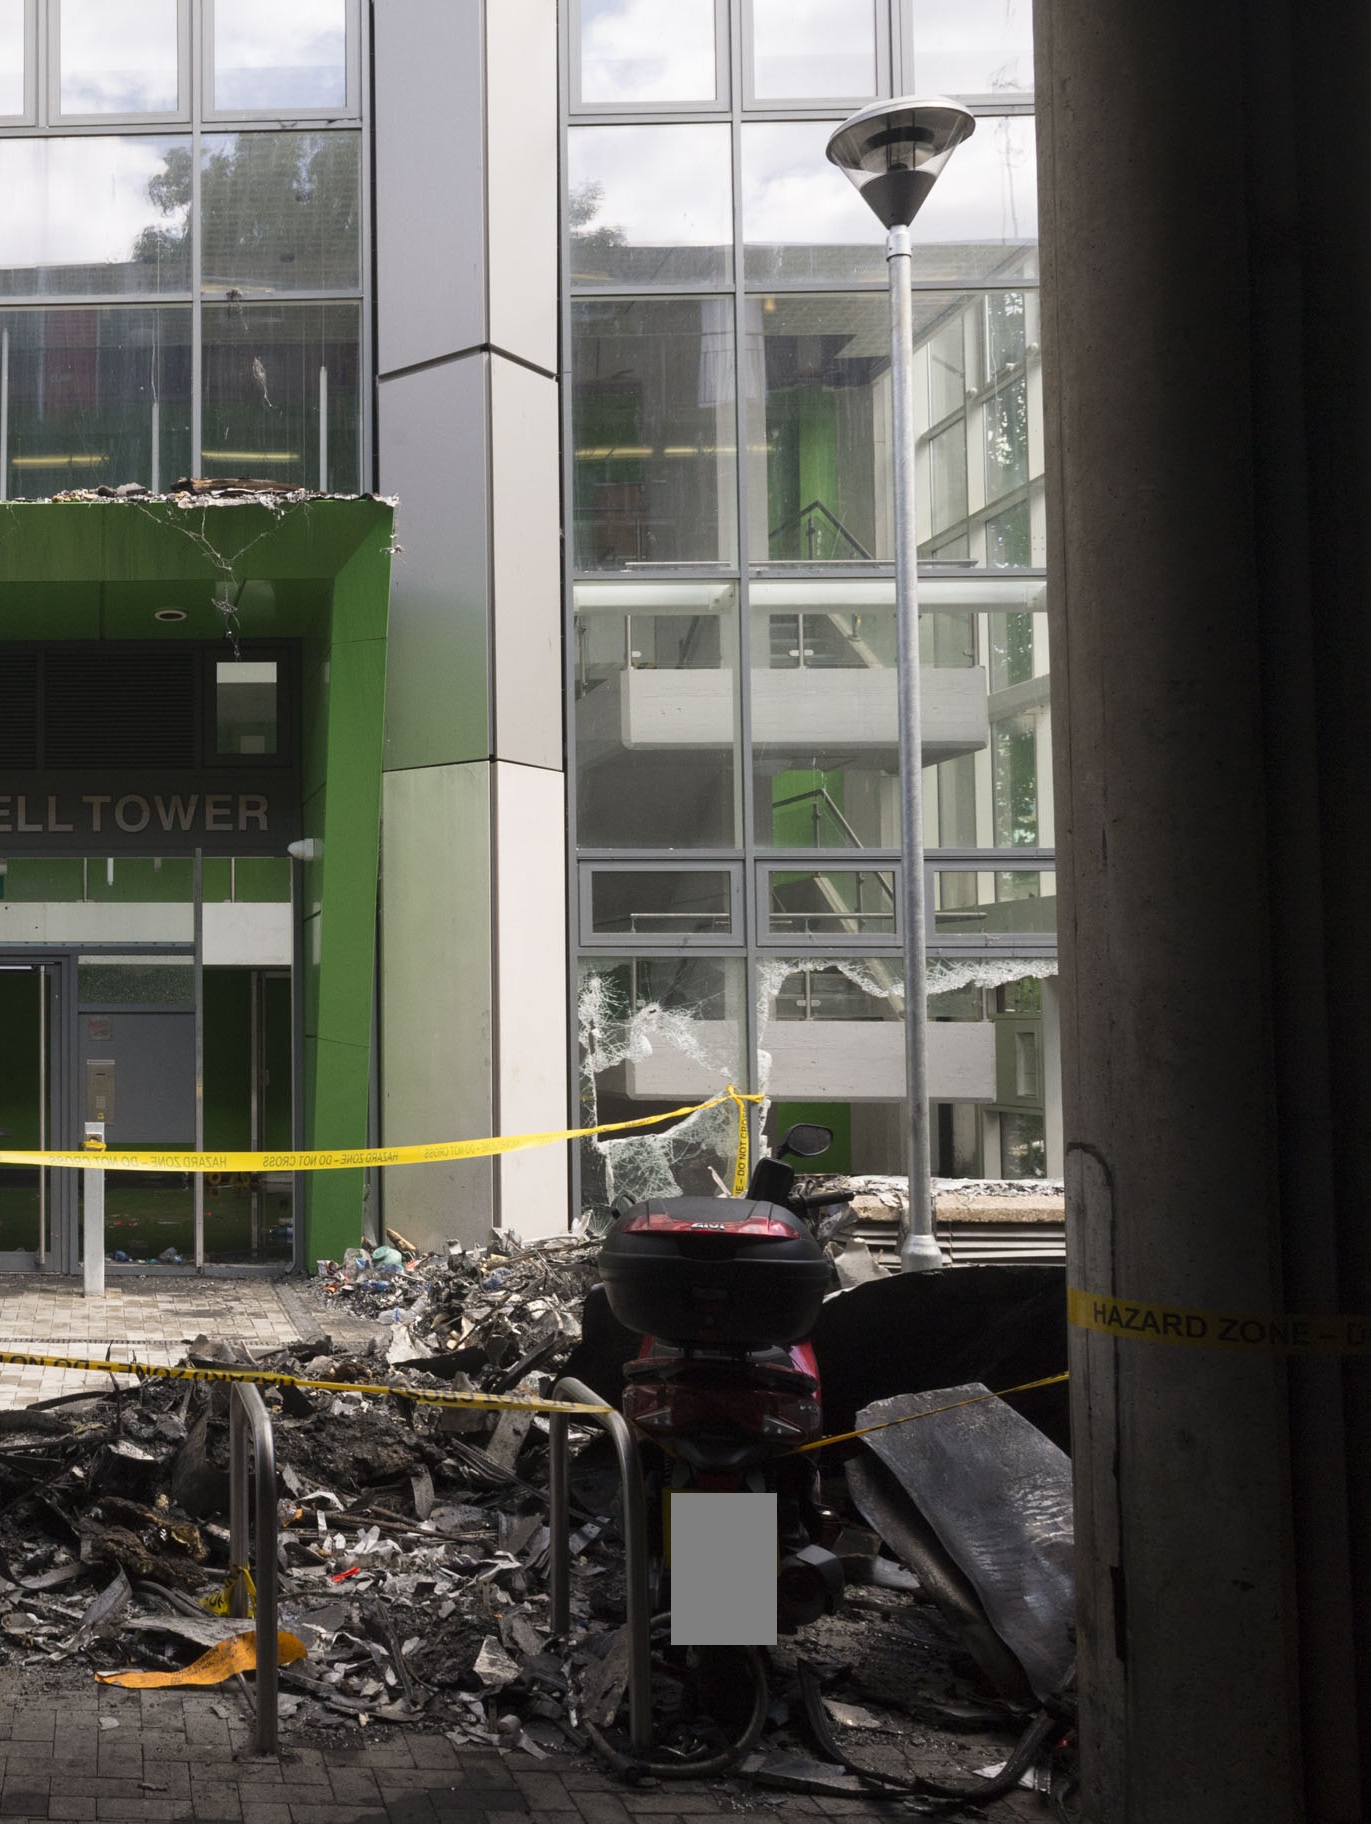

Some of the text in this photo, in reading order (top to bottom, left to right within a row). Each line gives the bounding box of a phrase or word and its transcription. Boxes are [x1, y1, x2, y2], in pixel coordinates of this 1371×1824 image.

[83, 793, 269, 832] TOWER
[1093, 1301, 1207, 1339] HAZARD
[1218, 1317, 1311, 1346] ZONE
